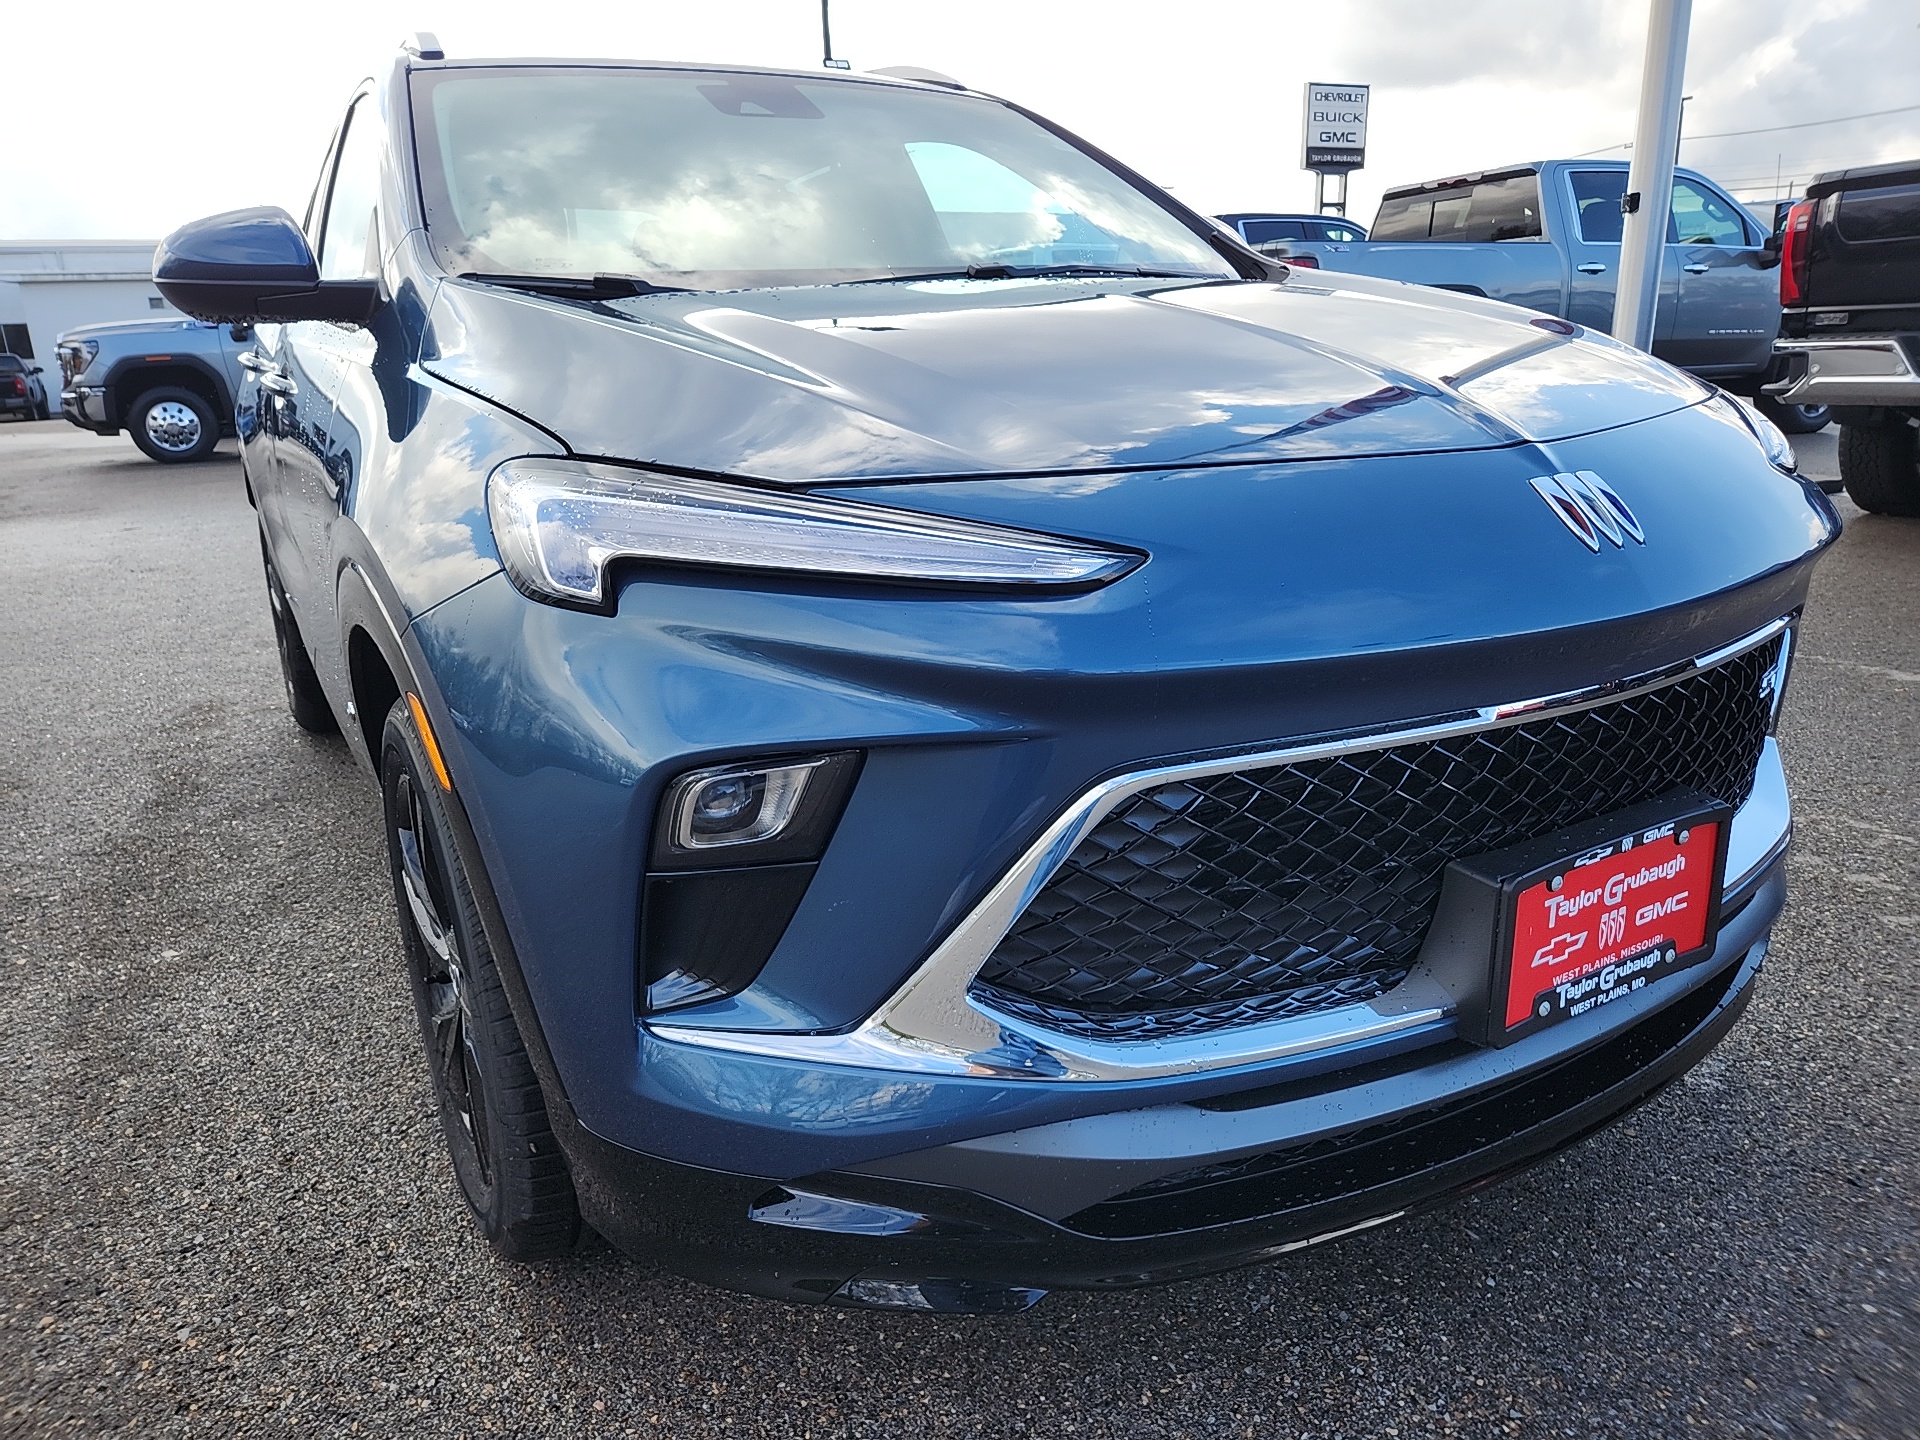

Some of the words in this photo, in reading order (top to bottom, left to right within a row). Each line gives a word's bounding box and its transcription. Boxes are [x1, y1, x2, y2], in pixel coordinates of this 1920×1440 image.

[1314, 91, 1365, 103] CHEVROLET
[1313, 111, 1364, 123] BUICK
[1319, 131, 1357, 143] GMC
[1642, 823, 1675, 844] GMC
[1544, 887, 1602, 929] Taylor
[1603, 853, 1686, 906] Grubaugh
[1635, 890, 1689, 927] GMC
[1552, 966, 1581, 987] WEST
[1582, 953, 1619, 975] PLAINS,
[1620, 933, 1664, 959] MISSOURI
[1556, 976, 1599, 1009] Taylor
[1599, 948, 1661, 991] Grubaugh
[1570, 996, 1598, 1017] WEST
[1597, 983, 1630, 1006] PLAINS,
[1631, 976, 1646, 991] MO
